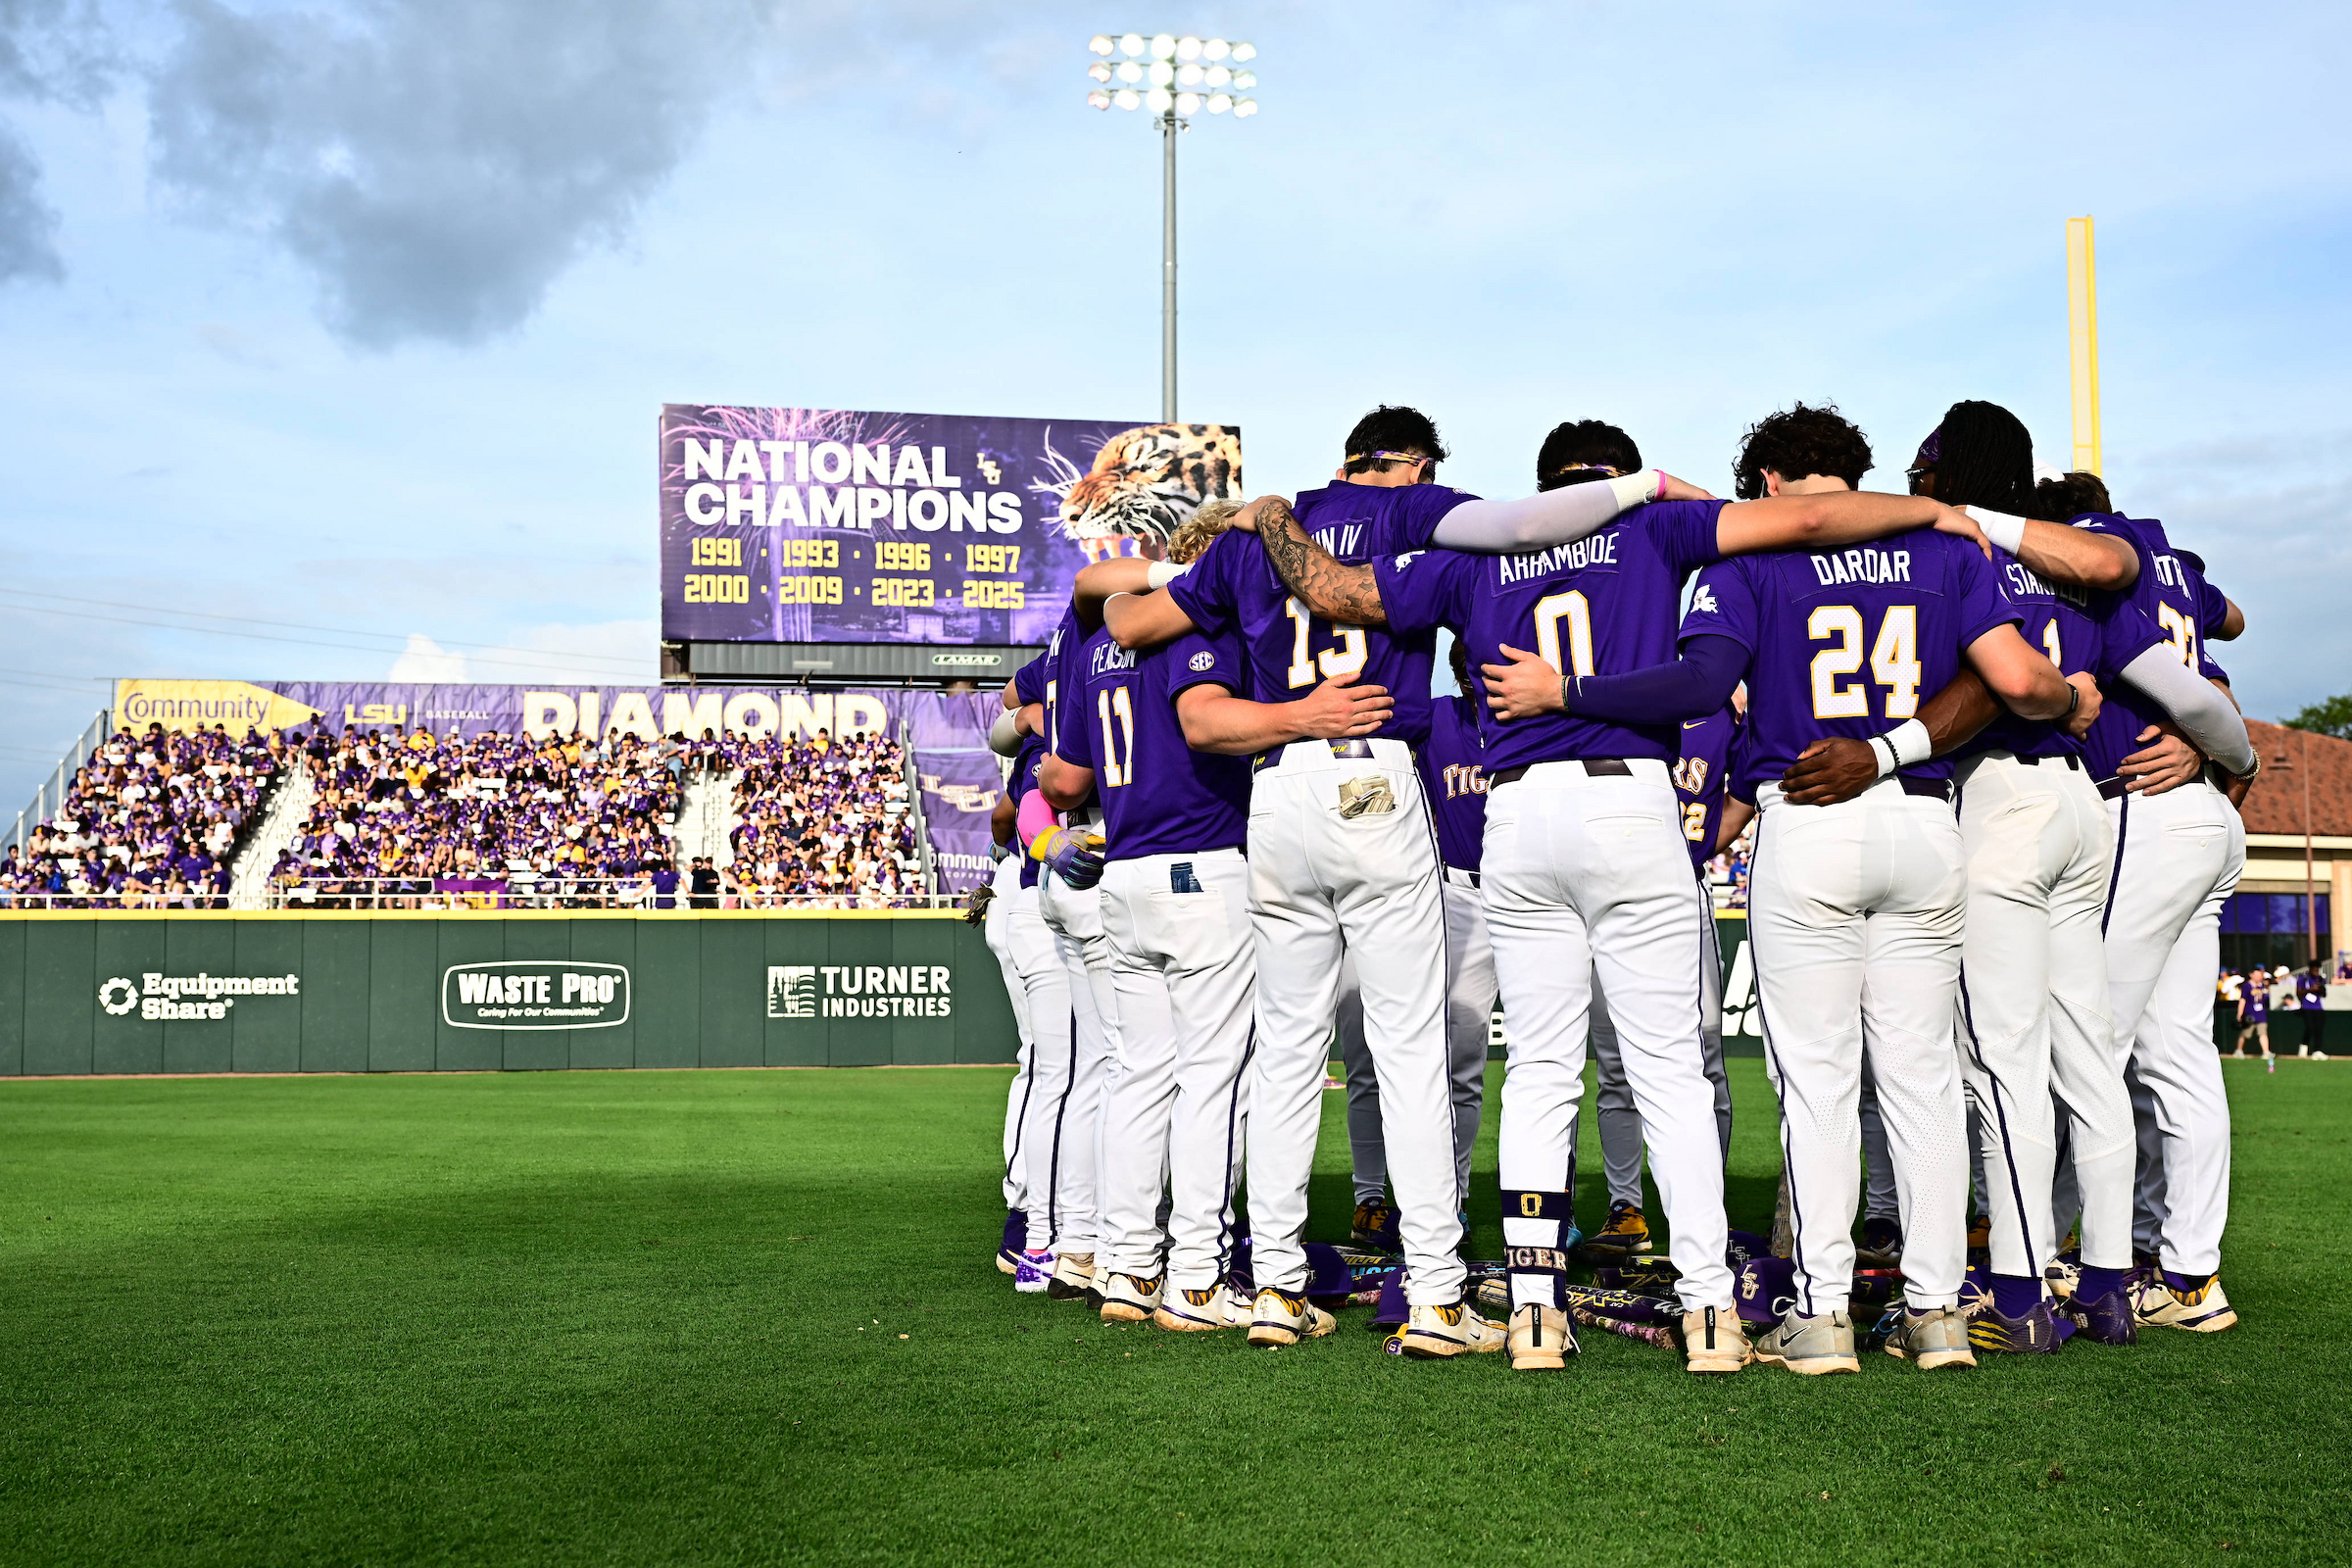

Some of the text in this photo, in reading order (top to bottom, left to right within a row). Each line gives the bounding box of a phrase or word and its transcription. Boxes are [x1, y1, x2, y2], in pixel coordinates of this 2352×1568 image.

[684, 438, 961, 488] NATIONAL
[976, 452, 1002, 485] LSU
[684, 482, 1023, 534] CHAMPIONS
[692, 537, 1021, 573] 1991 1993 1996 1997
[1810, 548, 1911, 586] DARDAR
[684, 574, 1025, 610] 2000 2009 2023 2025
[939, 656, 995, 665] LAMAR
[1190, 653, 1214, 670] SEC
[1807, 605, 1923, 719] 24
[123, 692, 269, 725] Community
[345, 704, 490, 724] LSU BASEBALL
[522, 692, 888, 743] DIAMOND
[1098, 686, 1134, 788] 11
[918, 772, 999, 812] LSU
[945, 870, 989, 881] COFFEE
[142, 973, 300, 1000] Equipment
[458, 973, 614, 1004] WASTE PRO
[819, 965, 952, 995] TURNER
[141, 998, 226, 1020] Share
[477, 1006, 601, 1019] Caring For Our Communities
[822, 997, 952, 1017] INDUSTRIES
[1740, 1263, 1760, 1300] LSU
[2026, 1319, 2035, 1345] 1
